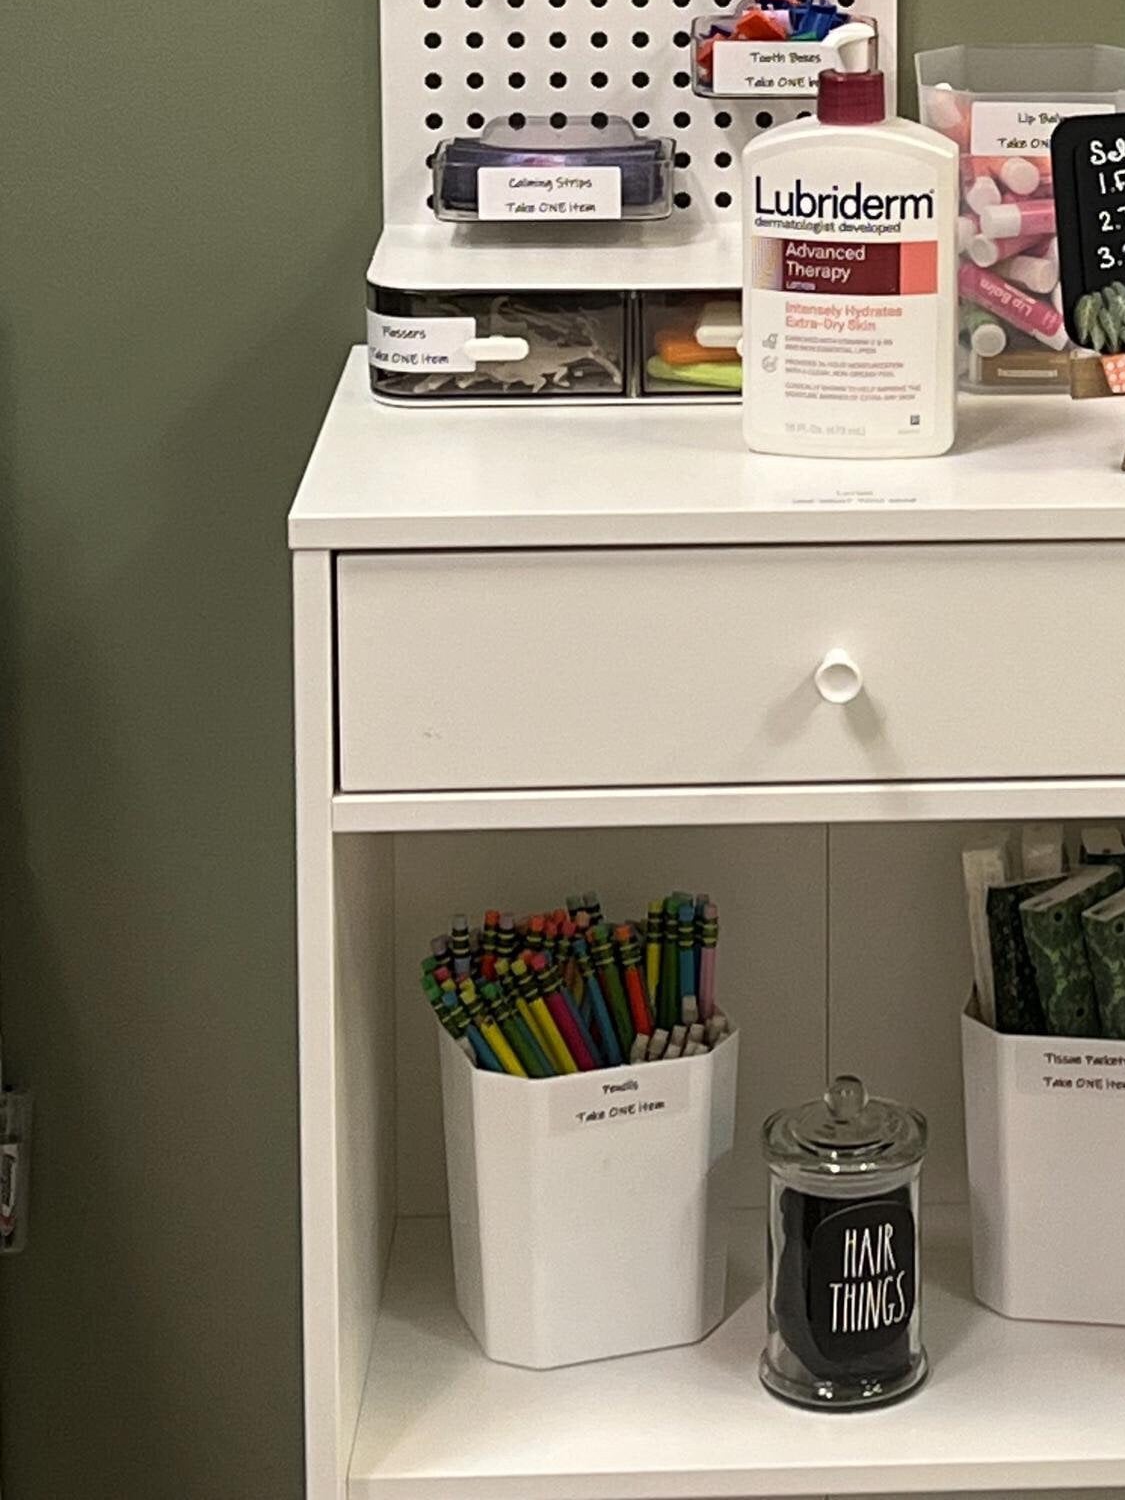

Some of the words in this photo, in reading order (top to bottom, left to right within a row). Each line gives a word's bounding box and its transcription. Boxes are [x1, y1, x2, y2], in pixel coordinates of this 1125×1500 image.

[778, 77, 806, 88] ONE
[556, 177, 592, 188] Strips
[539, 203, 566, 212] ONE
[755, 217, 835, 233] dermatologist
[838, 223, 901, 235] developed
[785, 243, 866, 261] Advanced
[786, 260, 851, 283] Therapy
[785, 302, 841, 318] Intensely
[845, 305, 902, 318] Hydrates
[785, 317, 845, 332] Extra-Dry
[849, 320, 876, 331] Skin
[1076, 1078, 1103, 1090] ONE
[609, 1104, 635, 1117] ONE
[844, 1223, 896, 1278] HAIR
[829, 1270, 906, 1332] THINGS
